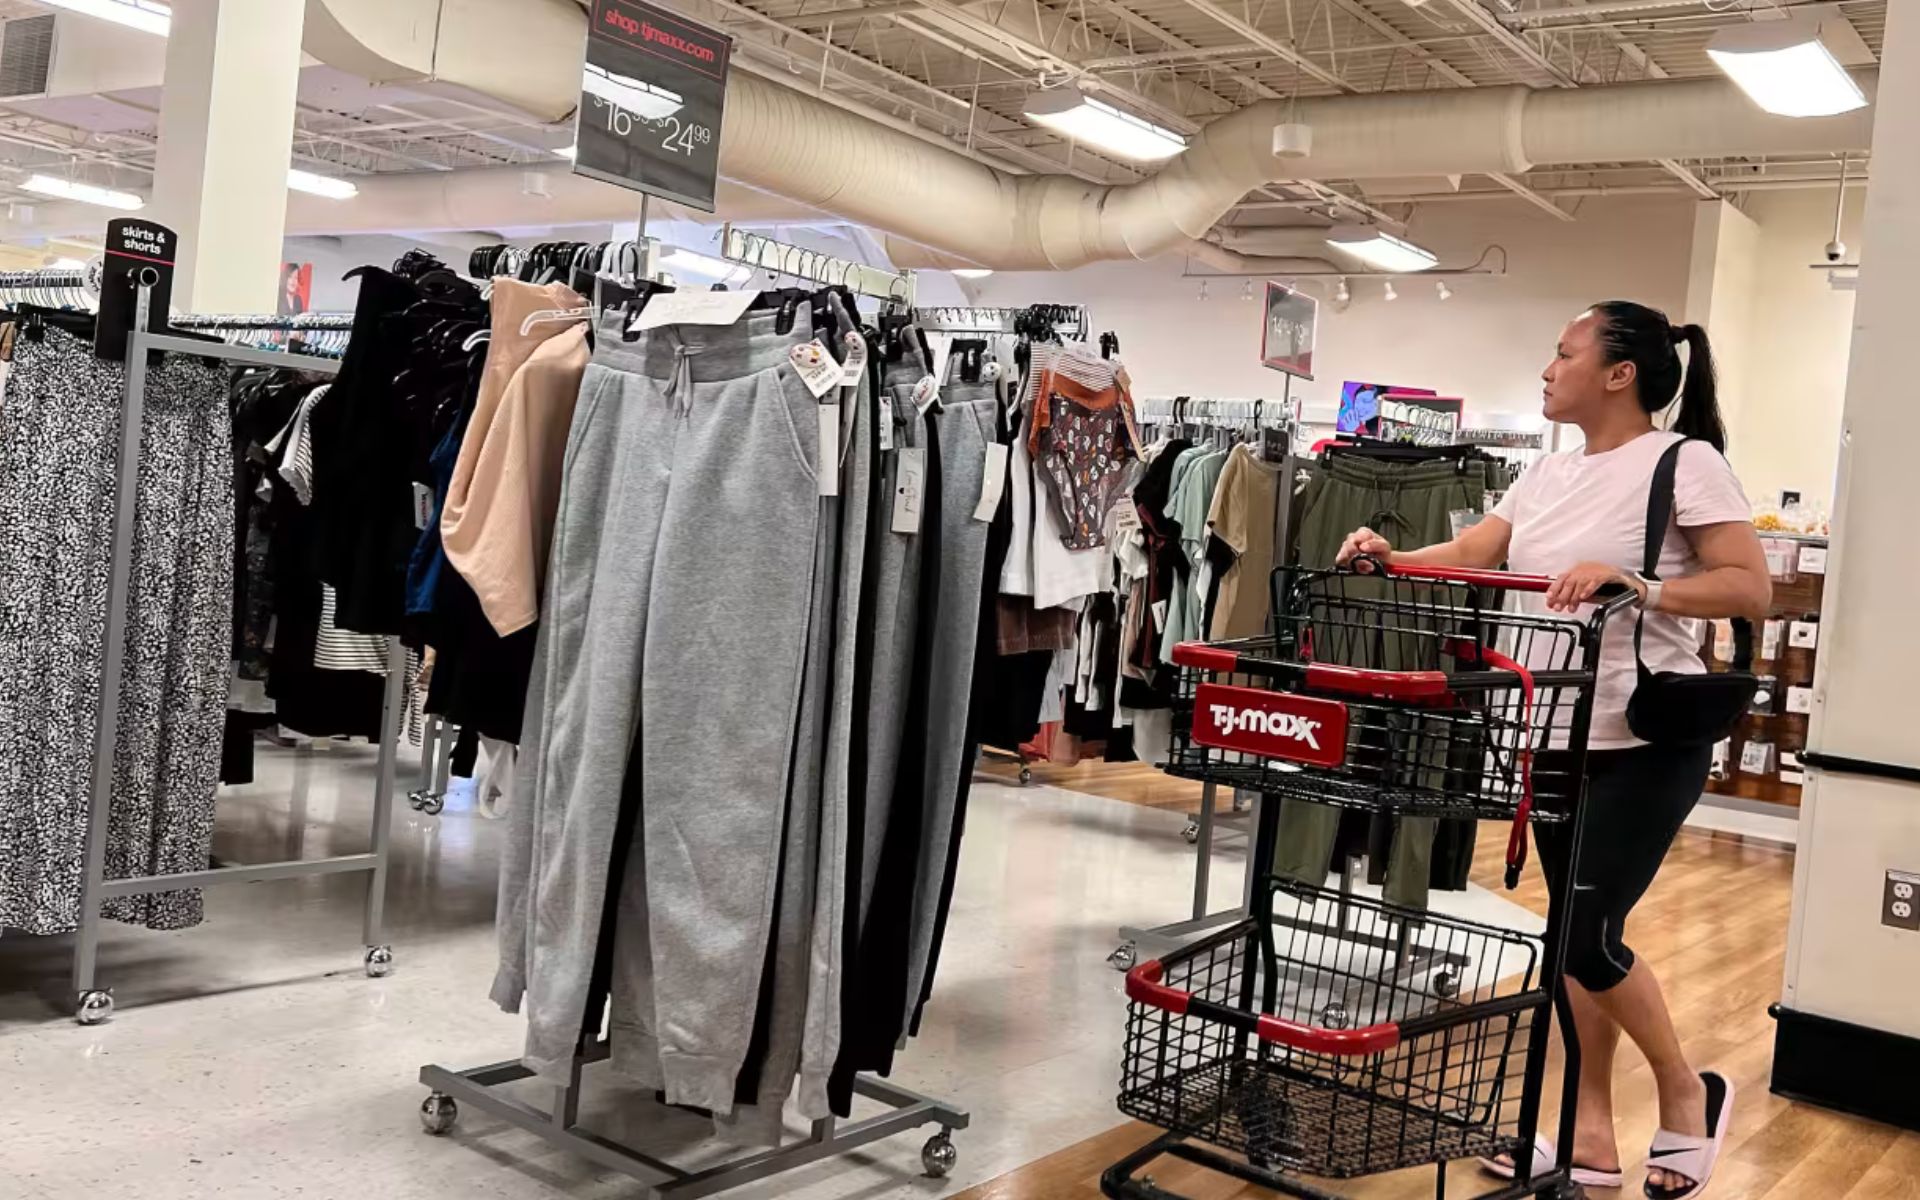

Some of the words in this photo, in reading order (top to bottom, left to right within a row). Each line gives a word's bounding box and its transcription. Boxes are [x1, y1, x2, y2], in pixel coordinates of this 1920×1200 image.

[604, 9, 639, 35] shop
[641, 20, 715, 62] tjmaxx.com
[122, 225, 154, 241] skirts
[157, 231, 165, 243] &
[124, 238, 161, 255] shorts
